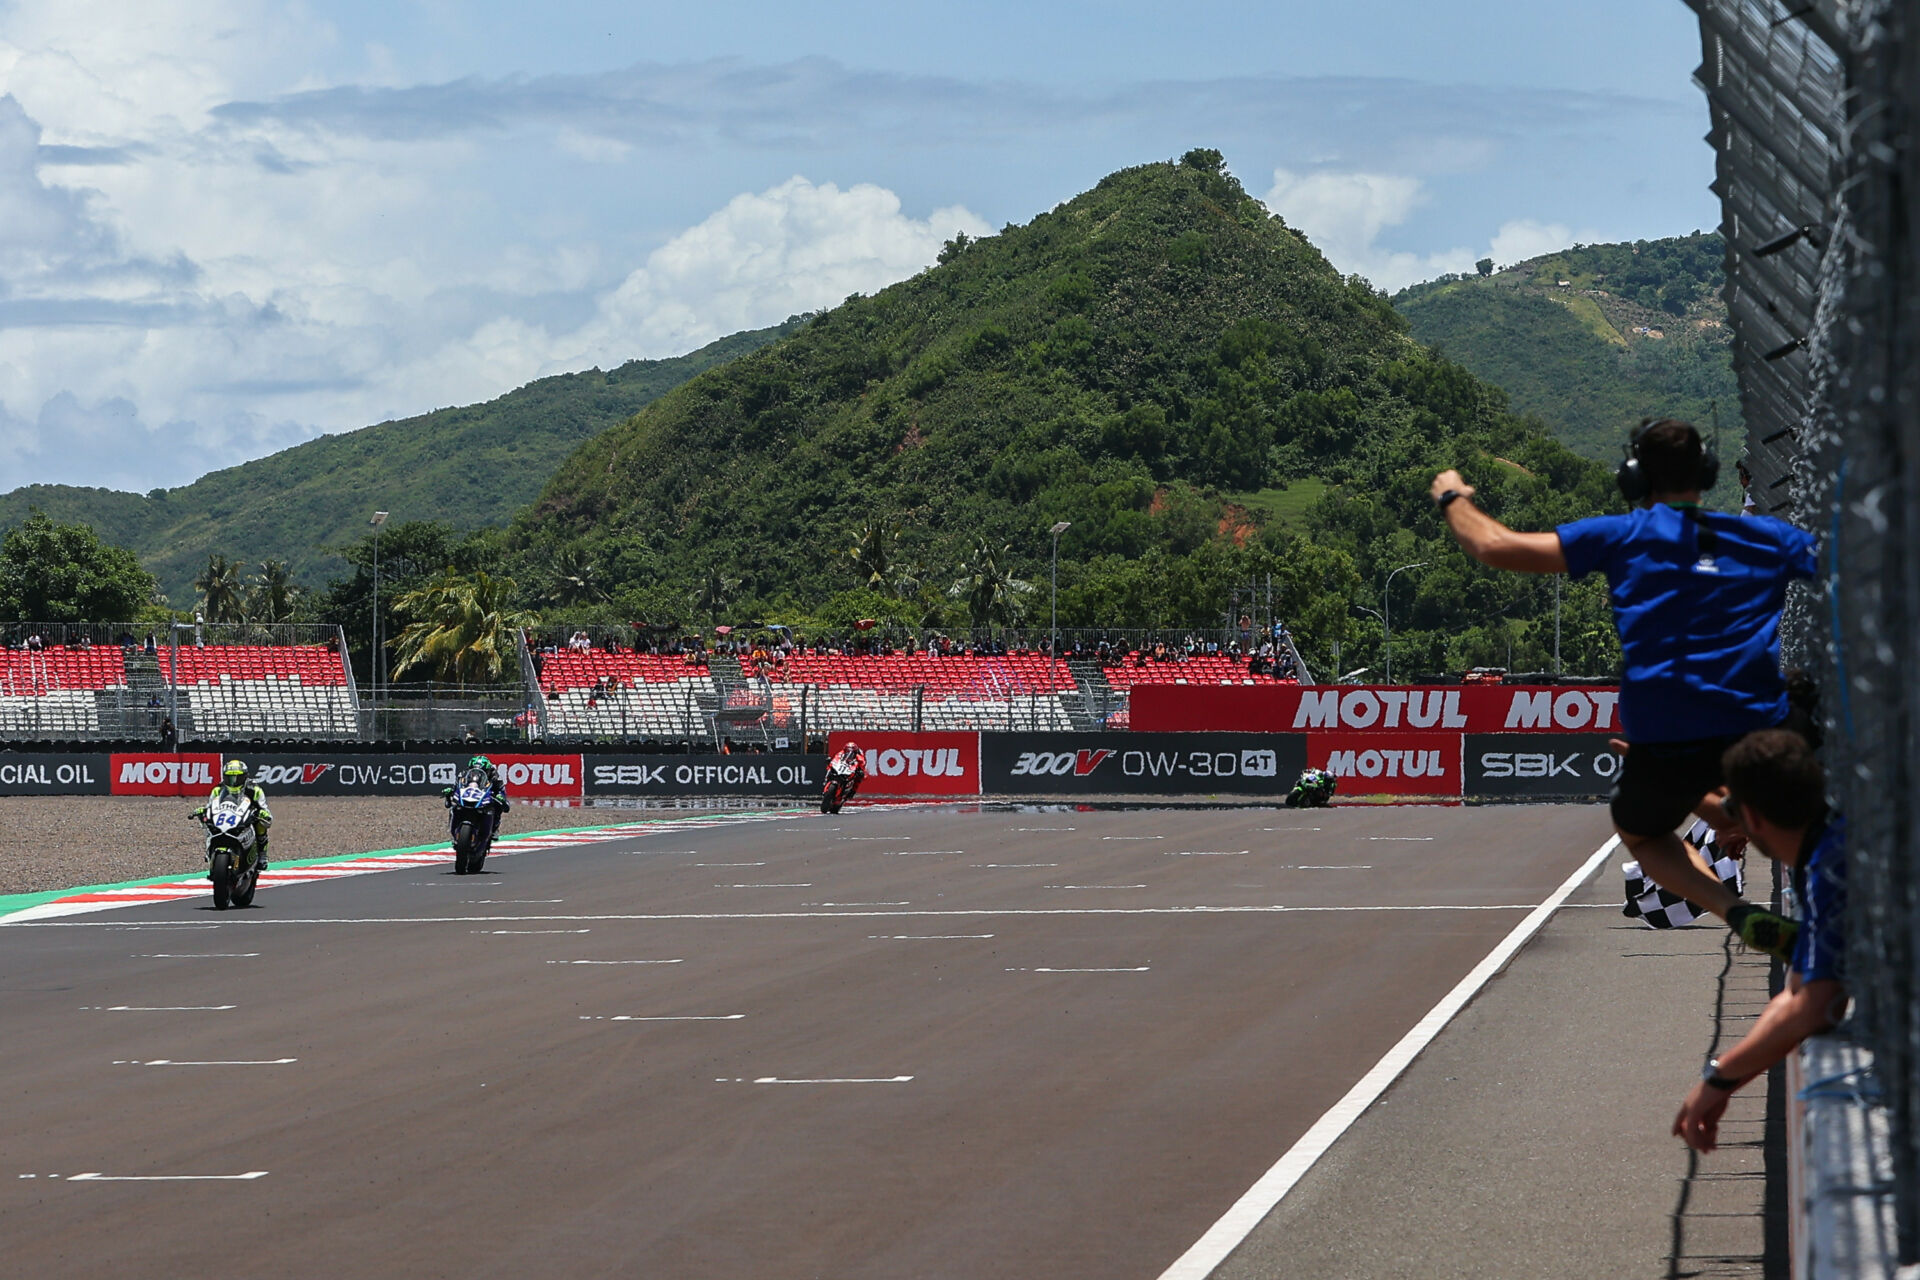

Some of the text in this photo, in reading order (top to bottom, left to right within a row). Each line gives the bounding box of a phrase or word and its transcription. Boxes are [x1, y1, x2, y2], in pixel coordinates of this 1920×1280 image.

[1294, 690, 1468, 728] MOTUL
[0, 765, 95, 784] CIAL OIL
[121, 762, 214, 784] MOTUL
[595, 765, 813, 784] SBK OFFICIAL OIL
[1326, 750, 1445, 777] MOTUL
[1482, 753, 1581, 776] SBK
[215, 813, 236, 827] 64
